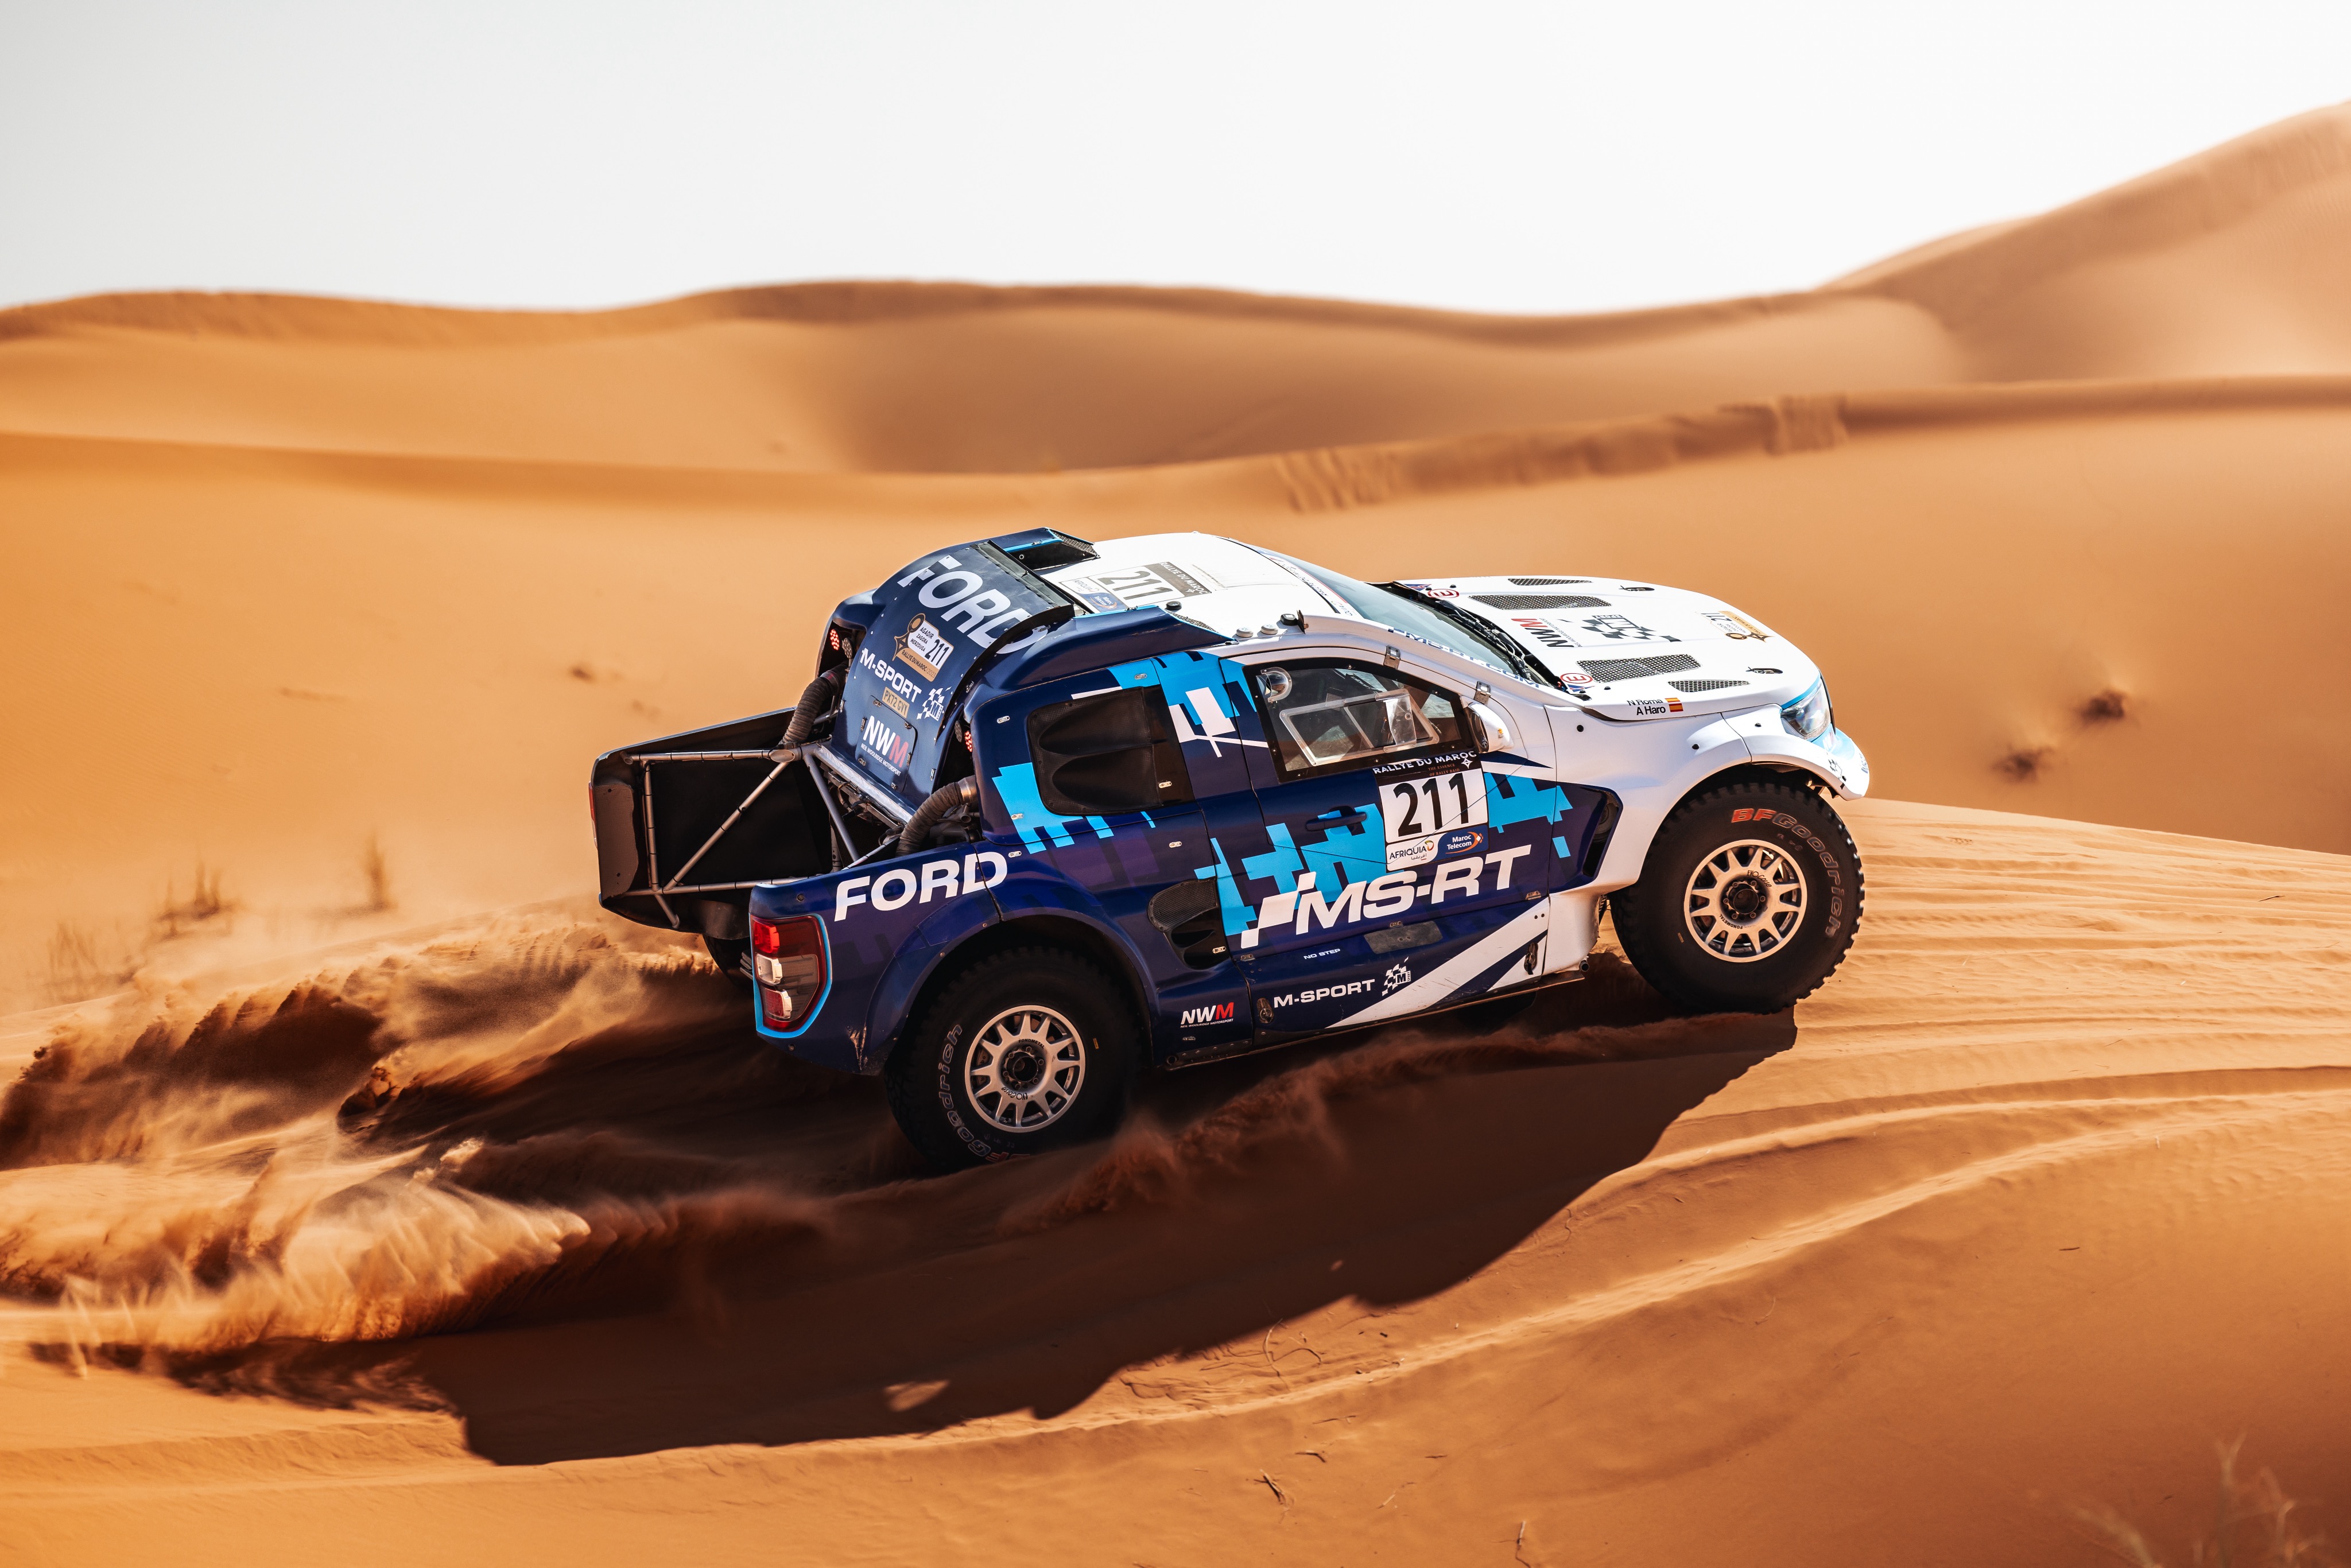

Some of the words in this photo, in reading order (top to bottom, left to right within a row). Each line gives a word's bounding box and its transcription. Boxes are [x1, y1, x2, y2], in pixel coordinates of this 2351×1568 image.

[1097, 570, 1174, 600] 211
[1159, 562, 1182, 575] RALLYE
[1184, 579, 1208, 595] MAROC
[897, 554, 1048, 654] FORD
[910, 638, 926, 652] MERZOUGA
[916, 633, 928, 645] ZAGORA
[920, 627, 934, 639] AGADIR
[1511, 618, 1575, 647] NWM
[901, 650, 914, 661] RALLYE
[915, 660, 928, 671] MAROC
[924, 639, 950, 666] 211
[859, 647, 922, 703] M-SPORT
[883, 689, 898, 707] PX72
[897, 701, 908, 716] GVY
[1636, 707, 1644, 715] A
[1644, 705, 1666, 715] Haro
[863, 715, 909, 768] NWM
[882, 759, 901, 777] MOTORSPORT
[1372, 761, 1414, 774] RALLYE
[1416, 758, 1432, 767] DU
[1435, 751, 1477, 763] MAROC
[1393, 773, 1469, 837] 211
[1446, 841, 1472, 851] Telecom
[1452, 835, 1472, 843] Maroc
[1389, 846, 1427, 860] AFRIQUIA
[1731, 808, 1844, 937] BFGoodrich
[834, 852, 1008, 922] FORD
[1296, 844, 1532, 935] MS-RT
[1719, 913, 1743, 930] FONDMETAL
[1318, 948, 1341, 957] STEP
[1274, 979, 1375, 1008] M-SPORT
[1180, 1002, 1234, 1025] NWM
[1018, 1038, 1045, 1050] FONDMETAL
[938, 1024, 1030, 1164] FGoodrich
